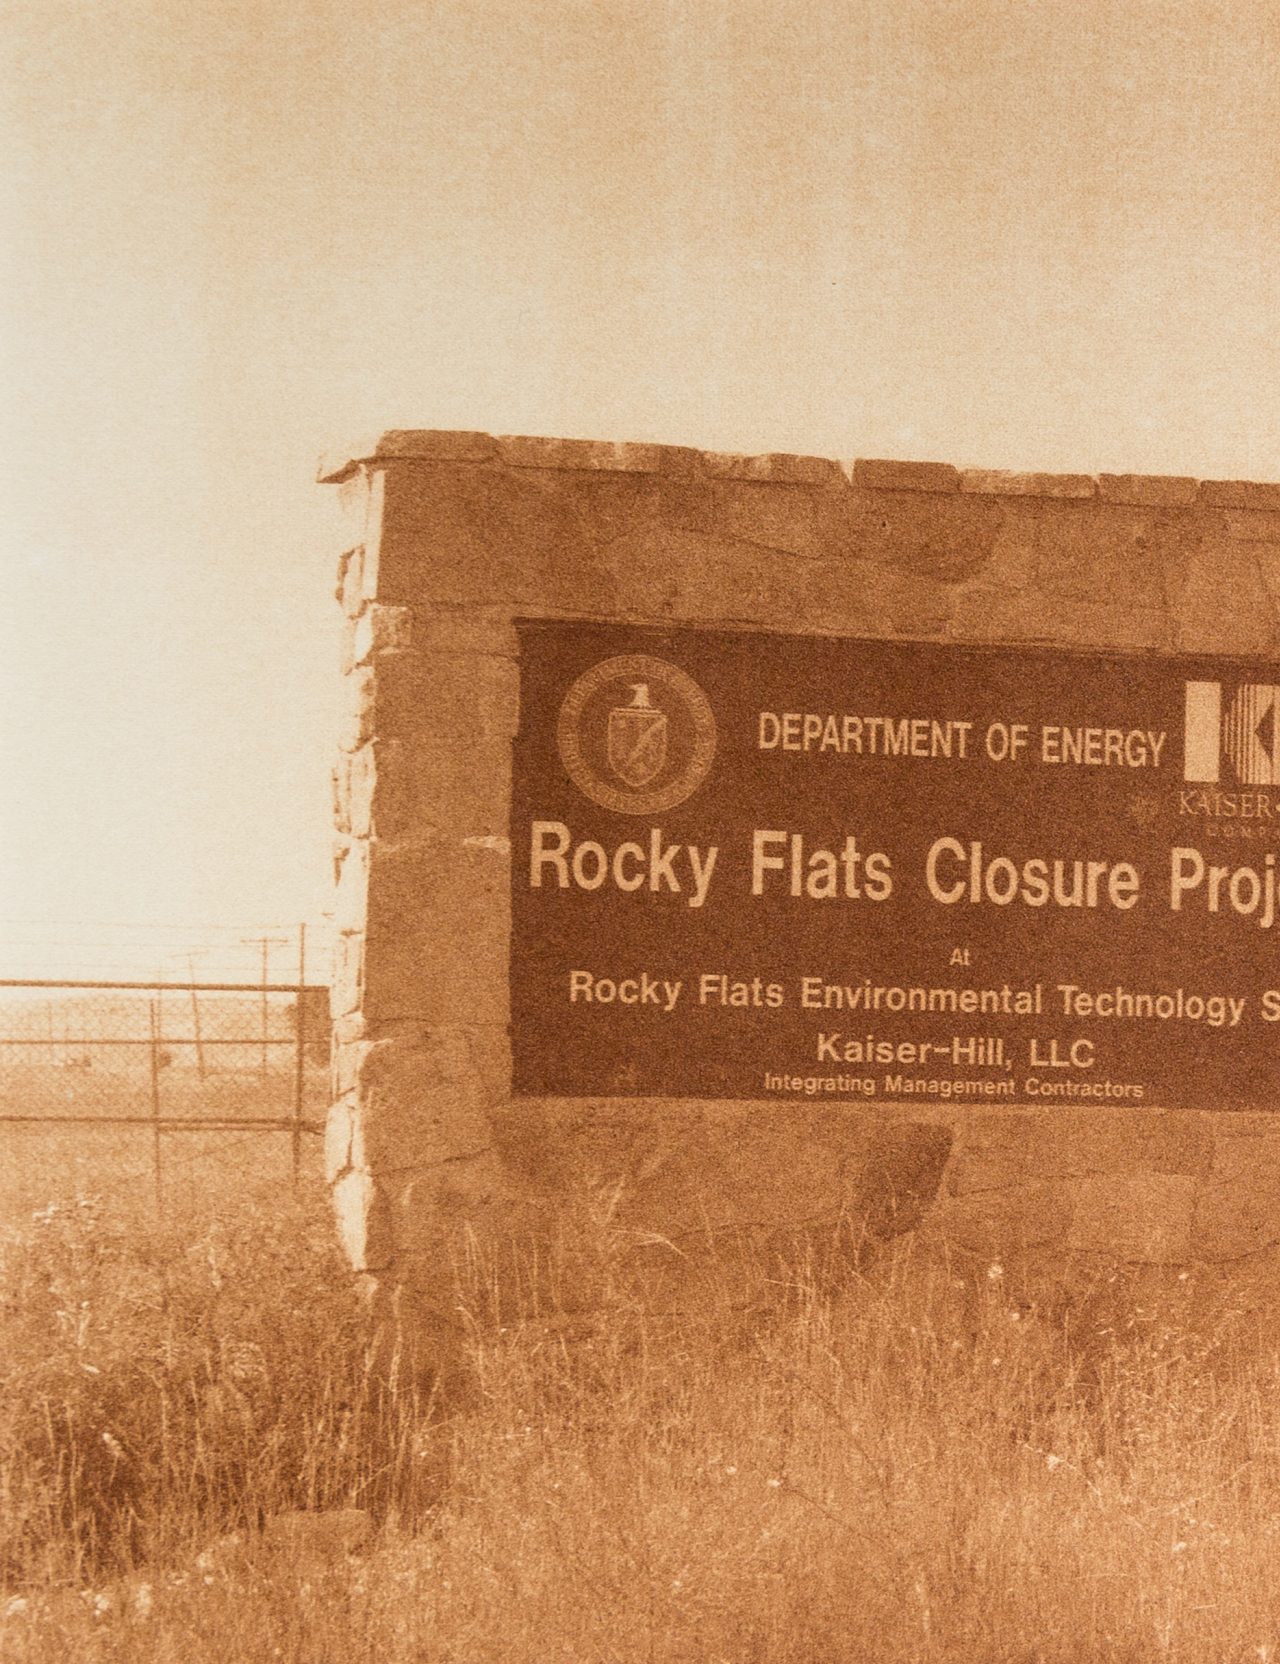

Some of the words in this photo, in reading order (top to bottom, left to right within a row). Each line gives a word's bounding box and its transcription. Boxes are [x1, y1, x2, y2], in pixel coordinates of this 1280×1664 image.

[758, 711, 972, 758] DEPARTMENT
[985, 722, 1028, 762] OF
[1041, 726, 1167, 768] ENERGY
[529, 821, 718, 907] Rocky
[751, 829, 893, 901] Flats
[926, 836, 1140, 910] Closure
[950, 948, 971, 966] At
[568, 971, 682, 1011] Rocky
[700, 974, 784, 1008] Flats
[801, 977, 1042, 1015] Environmental
[1057, 984, 1245, 1026] Technology
[816, 1033, 1013, 1070] Kaiser-Hill,
[1030, 1039, 1096, 1069] LLC
[764, 1072, 876, 1096] Integrating
[884, 1075, 1015, 1098] Management
[1025, 1079, 1144, 1099] Contractors
